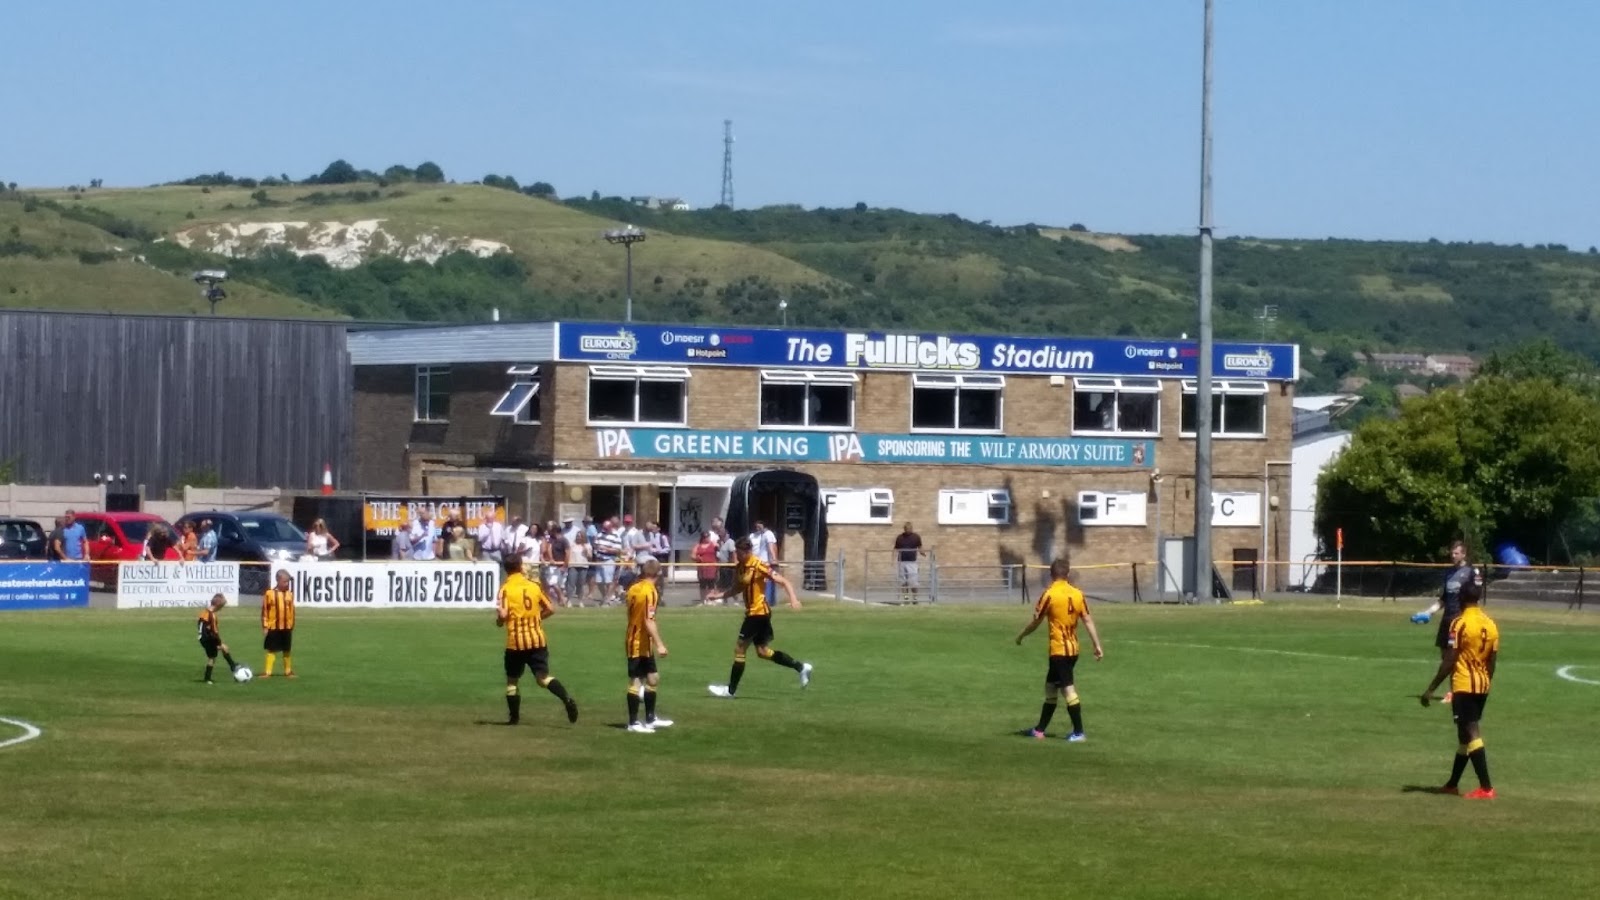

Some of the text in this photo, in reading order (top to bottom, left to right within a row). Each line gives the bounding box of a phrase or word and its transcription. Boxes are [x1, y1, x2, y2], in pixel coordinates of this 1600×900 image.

[584, 337, 631, 350] EURONICS
[786, 333, 1094, 370] The Fullicks Stadium
[695, 349, 727, 358] Hotpoint
[1227, 358, 1268, 368] EURONICS
[597, 429, 809, 457] IPA GREENE KING
[829, 433, 865, 461] IPA
[877, 439, 1126, 462] SPONSORING THE WILF ARMORY SUITE
[371, 501, 402, 520] THE
[1105, 497, 1117, 515] F
[1221, 498, 1235, 516] C
[123, 564, 235, 579] RUSSELL & WHEELER
[122, 584, 234, 594] ELECTRICAL CONTRACTORS
[289, 570, 495, 603] lkestone Taxis 252000
